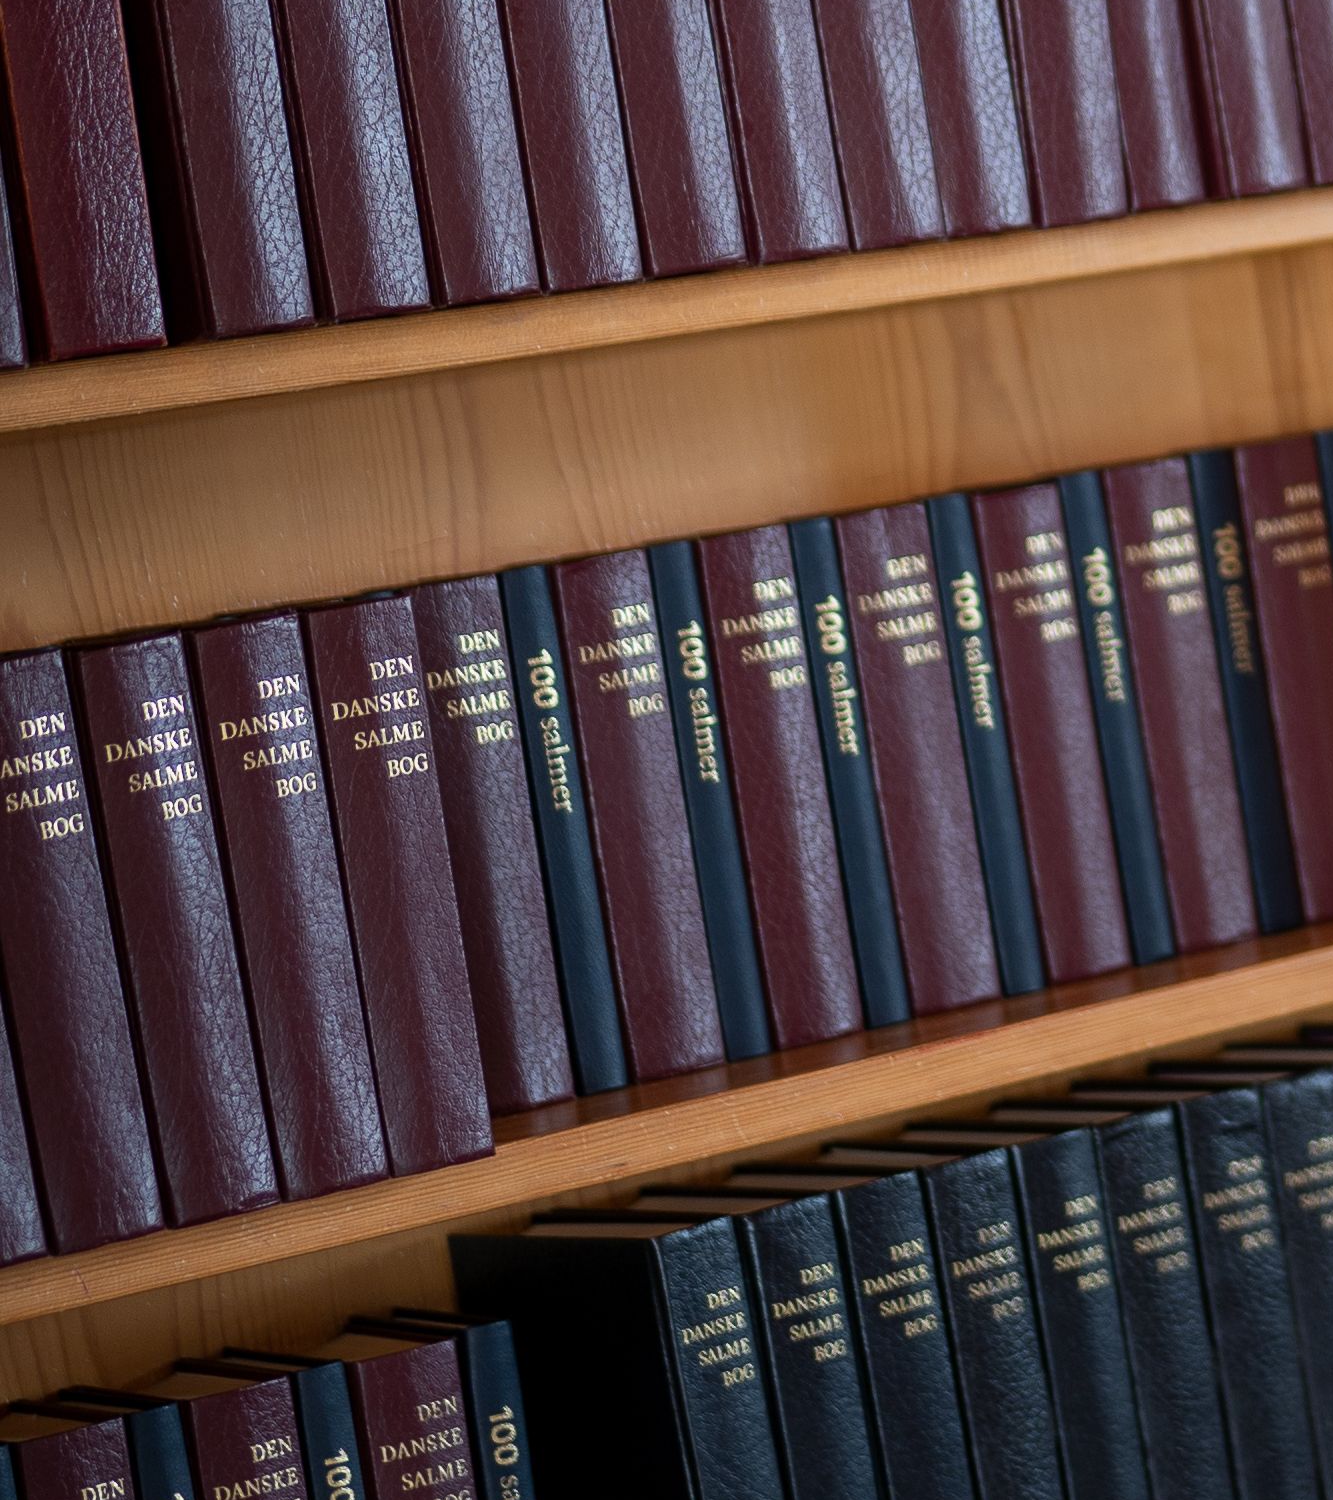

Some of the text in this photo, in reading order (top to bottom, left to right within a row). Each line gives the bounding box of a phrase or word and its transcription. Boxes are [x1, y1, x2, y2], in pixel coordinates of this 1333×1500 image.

[753, 578, 793, 599] DEN
[611, 604, 649, 627] DEN
[721, 608, 796, 636] DANSKE
[458, 630, 500, 654] DEN
[580, 634, 655, 664] DANSKE
[741, 637, 801, 663] SALME
[370, 656, 414, 681] DEN
[426, 659, 506, 690] DANSKE
[599, 664, 660, 692] SALME
[770, 666, 806, 690] BOG
[815, 595, 859, 756] 100 salmer
[258, 675, 300, 699] DEN
[142, 696, 185, 721] DEN
[332, 688, 420, 721] DANSKE
[446, 690, 511, 719] SALME
[628, 694, 664, 717] BOG
[677, 620, 721, 784] 100 salmer
[19, 713, 65, 739] DEN
[219, 708, 307, 740] DANSKE
[354, 721, 425, 750] SALME
[475, 721, 514, 745] BOG
[527, 649, 573, 814] 100 salmer
[105, 728, 192, 763] DANSKE
[243, 740, 313, 771] SALME
[0, 747, 74, 778] ANSKE
[387, 754, 429, 778] BOG
[128, 762, 198, 792] SALME
[276, 774, 317, 798] BOG
[6, 781, 80, 812] SALME
[162, 796, 202, 820] BOG
[40, 814, 84, 840] BOG
[890, 1239, 925, 1263] DEN
[801, 1263, 835, 1285] DEN
[863, 1264, 929, 1295] DANSKE
[706, 1286, 741, 1310] DEN
[772, 1288, 839, 1319] DANSKE
[880, 1289, 933, 1317] SALME
[682, 1312, 746, 1344] DANSKE
[790, 1313, 843, 1341] SALME
[904, 1315, 938, 1338] BOG
[698, 1338, 751, 1366] SALME
[814, 1340, 847, 1362] BOG
[722, 1364, 756, 1388] BOG
[418, 1397, 458, 1422] DEN
[252, 1436, 292, 1463] DEN
[381, 1427, 464, 1463] DANSKE
[489, 1405, 519, 1466] 100
[402, 1459, 469, 1491] SALME
